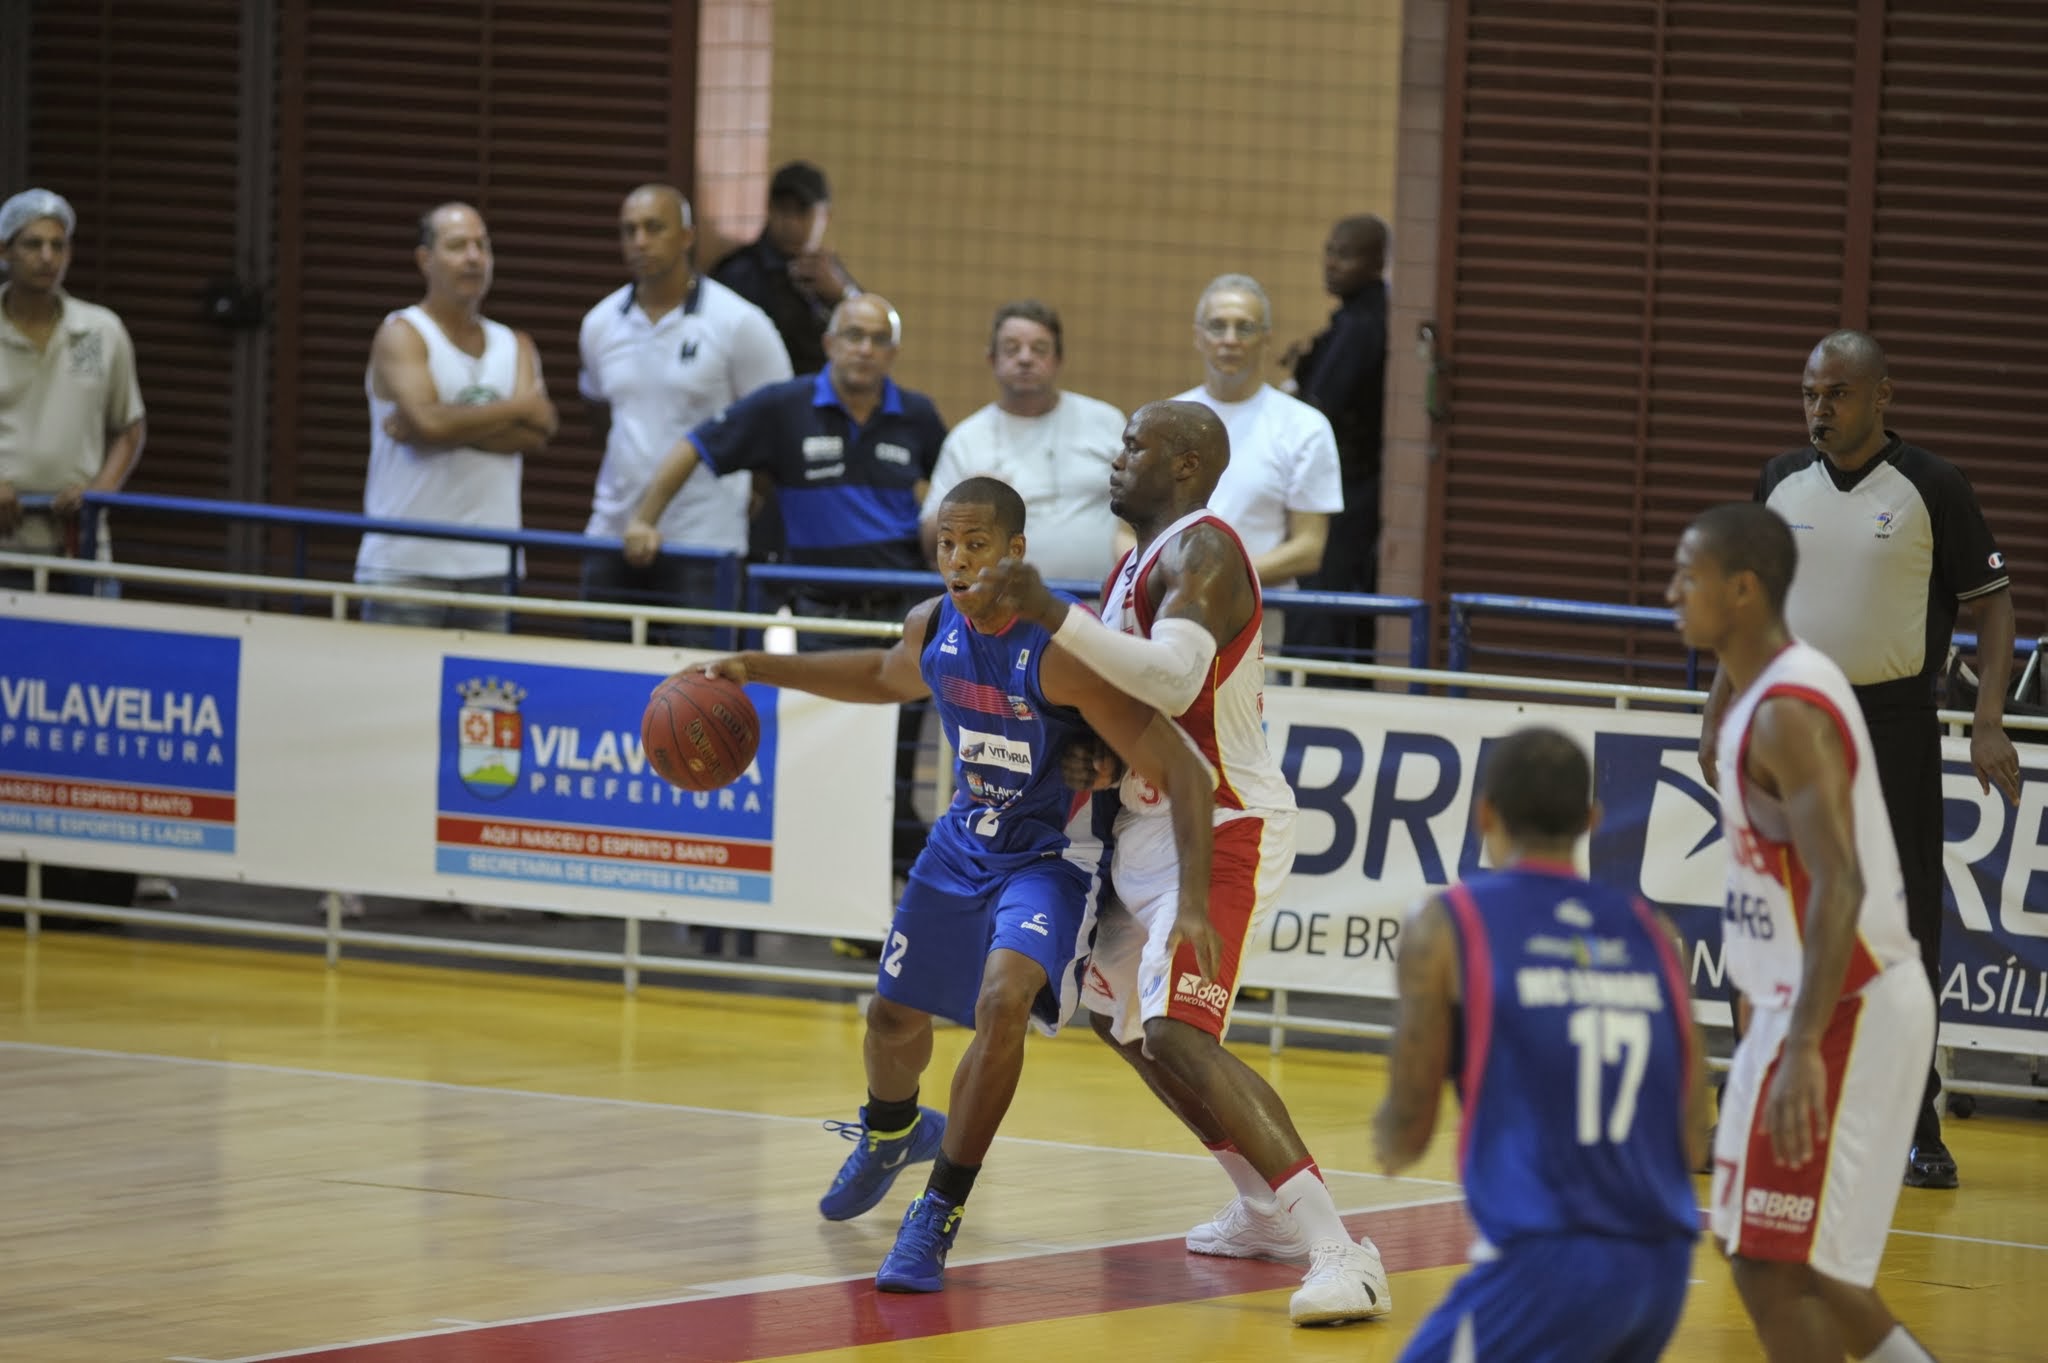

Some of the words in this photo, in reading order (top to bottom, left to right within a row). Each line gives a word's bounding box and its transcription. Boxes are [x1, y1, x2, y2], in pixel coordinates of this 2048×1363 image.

[0, 677, 222, 737] VILAVELHA
[2, 726, 223, 765] PREFEITURA
[141, 792, 193, 816] SANTO
[530, 772, 761, 813] PREFEITURA
[480, 825, 519, 848] AQUI
[520, 829, 585, 853] NASCEU
[586, 833, 600, 854] O
[674, 842, 729, 865] SANTO
[468, 853, 562, 877] SECRETARIA
[565, 861, 586, 880] DE
[590, 864, 672, 888] ESPORTES
[673, 871, 686, 890] E
[686, 872, 739, 895] LAZER
[1270, 910, 1330, 956] DE
[1939, 955, 2048, 1020] ASÍLI
[1568, 1008, 1650, 1145] 17
[1765, 1192, 1815, 1222] BRB
